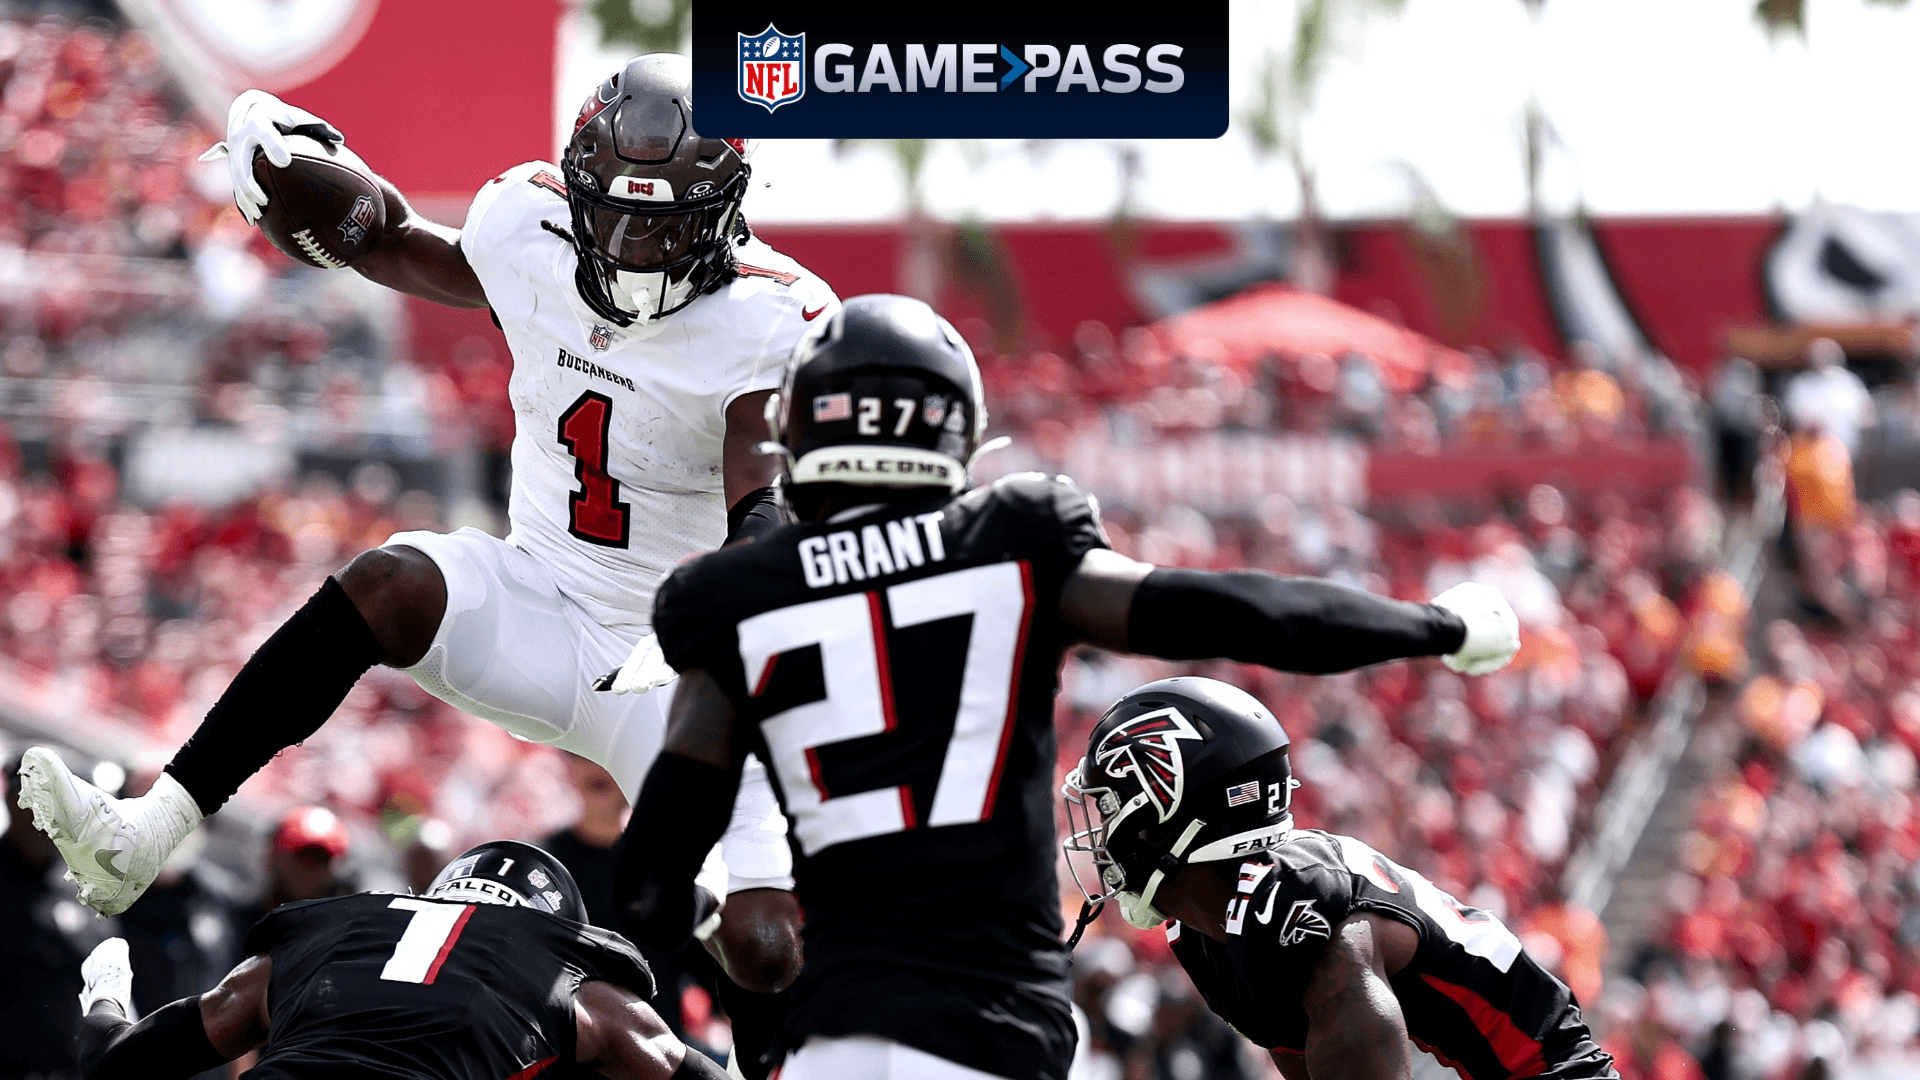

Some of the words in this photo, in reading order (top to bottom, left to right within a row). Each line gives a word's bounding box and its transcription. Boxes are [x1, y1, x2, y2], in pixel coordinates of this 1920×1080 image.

[591, 333, 607, 349] NFL
[557, 347, 636, 392] BUCCANEERS
[858, 397, 917, 437] 27
[557, 389, 631, 550] 1
[818, 459, 950, 479] FALCONS
[798, 511, 946, 588] GRANT
[737, 559, 1036, 857] 27
[498, 858, 515, 877] 1
[380, 898, 477, 985] 1
